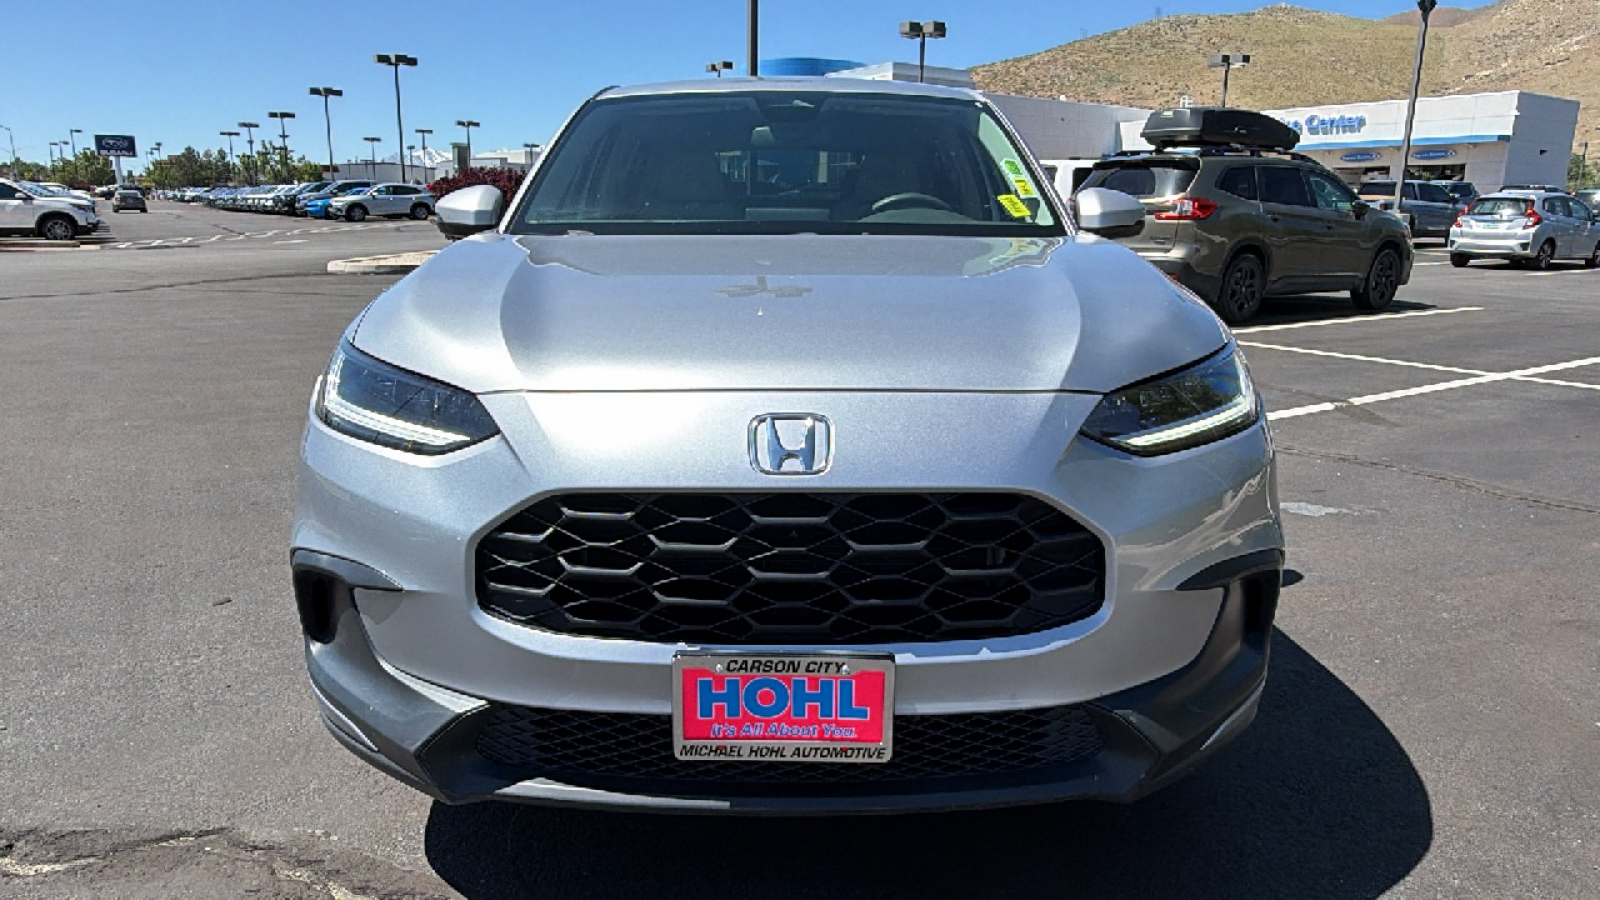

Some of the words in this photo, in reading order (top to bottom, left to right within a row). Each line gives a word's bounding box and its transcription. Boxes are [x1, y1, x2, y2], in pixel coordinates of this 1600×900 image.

[1305, 115, 1366, 131] Center
[726, 659, 801, 673] CARSON
[804, 660, 846, 674] CITY
[697, 676, 870, 720] HOHL
[711, 723, 736, 737] It's
[740, 723, 762, 737] All
[766, 722, 818, 738] About
[822, 723, 857, 738] You.
[679, 745, 744, 757] MICHAEL
[748, 745, 788, 758] HOHL
[790, 746, 886, 759] AUTOMOTIVE
